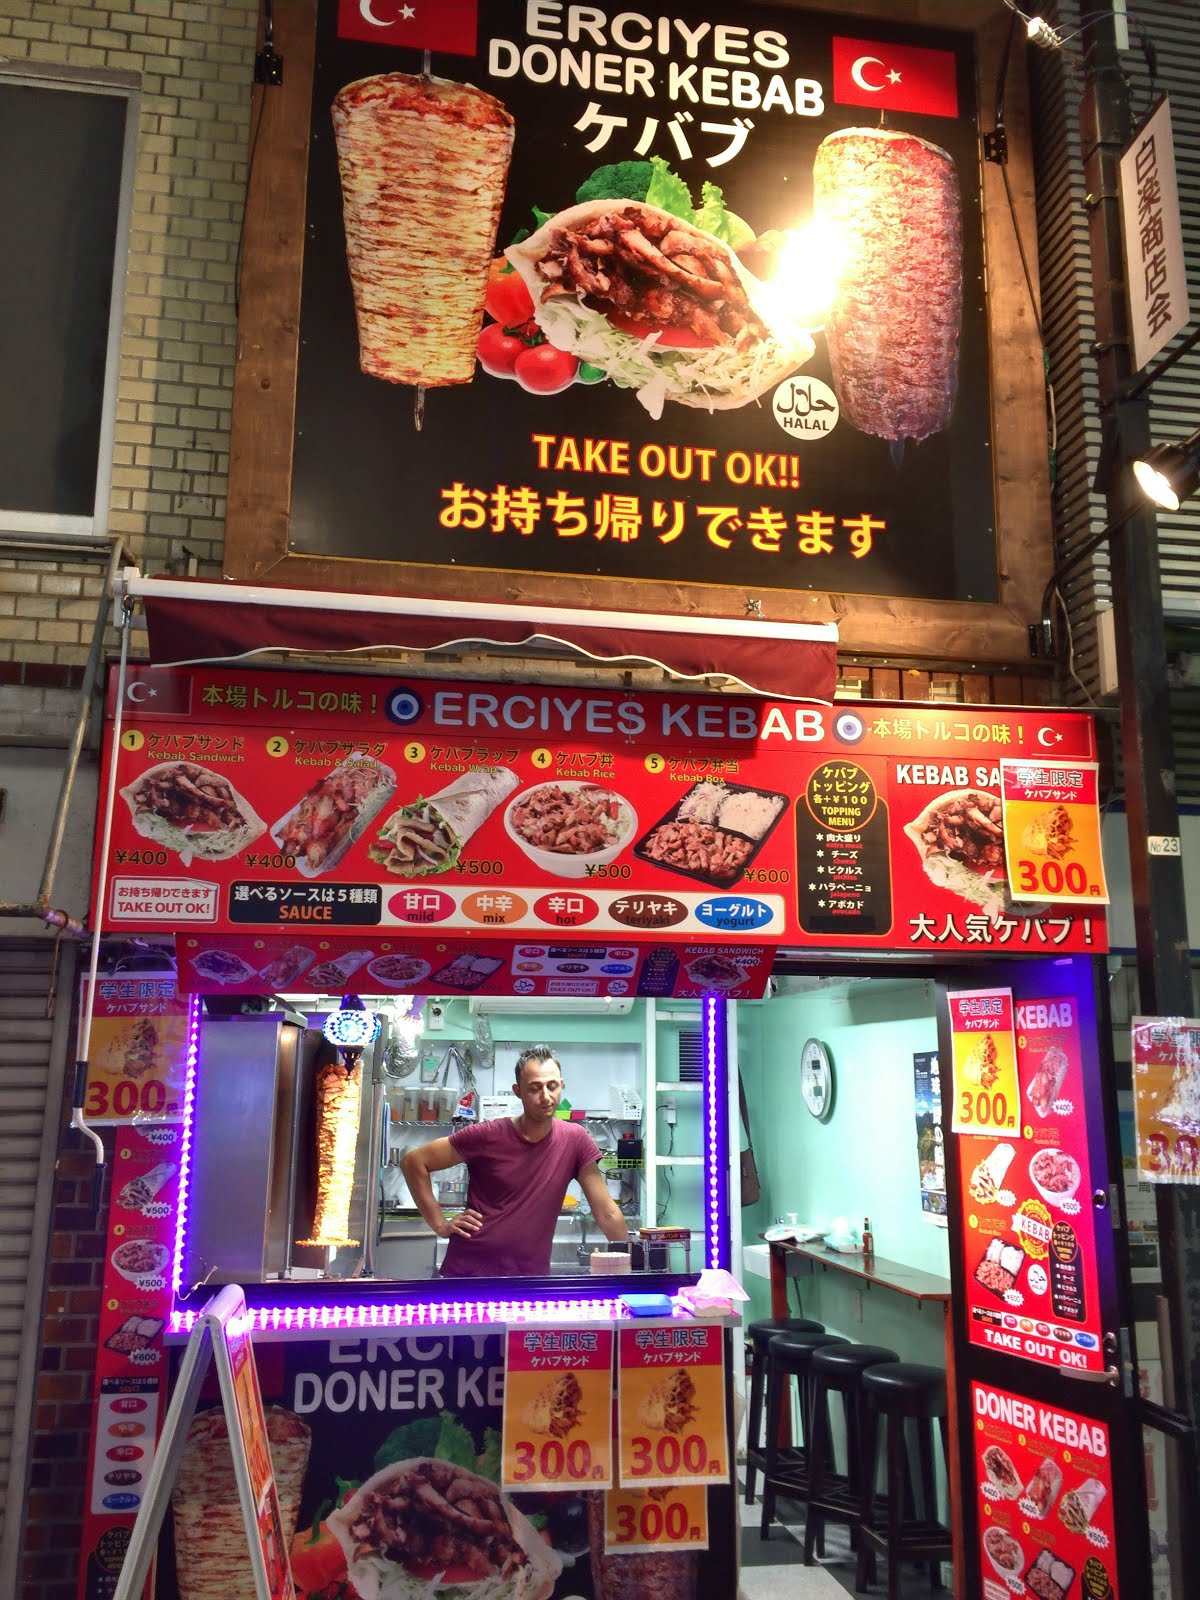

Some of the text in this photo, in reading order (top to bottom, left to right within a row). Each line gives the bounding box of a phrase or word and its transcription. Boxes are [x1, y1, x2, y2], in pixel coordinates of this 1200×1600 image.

[526, 0, 790, 69] ERCIYES
[488, 38, 825, 117] DONER KEBAB
[573, 101, 755, 168] ケバブ
[1134, 134, 1172, 339] 白楽商店会
[777, 383, 836, 415] حلال
[783, 416, 830, 432] HALAL
[532, 433, 801, 489] TAKE OUT OK!!
[438, 482, 886, 558] お持ち帰りできます
[201, 684, 378, 714] 本場トルコの味！
[433, 691, 825, 742] ERCIYES KEBAB
[873, 717, 1024, 745] 本場トルコの味！
[148, 733, 246, 751] ケバブサンド
[294, 739, 387, 758] ケバブサラダ
[147, 750, 245, 763] Kebab Sandwich
[430, 745, 520, 763] ケバブラップ
[555, 751, 614, 767] ケバブ丼
[295, 757, 378, 768] Kebab & Salad
[430, 762, 497, 776] Kebab Wrap
[668, 756, 739, 774] ケバブ弁当
[556, 768, 615, 779] Kebab Rice
[670, 773, 725, 783] Kebab Box
[822, 767, 858, 779] ケバブ
[896, 764, 969, 786] KEBAB
[1016, 768, 1084, 789] 学生限定
[812, 780, 871, 793] トッピング
[1024, 789, 1078, 801] ケバブサンド
[822, 807, 861, 817] TOPPING
[828, 817, 855, 827] MENU
[826, 833, 861, 843] 肉大盛り
[1163, 838, 1178, 852] 23
[115, 850, 168, 866] ¥400
[245, 853, 297, 869] ¥400
[831, 850, 858, 859] チーズ
[455, 860, 504, 875] ¥500
[585, 864, 632, 879] ¥500
[744, 868, 790, 883] ¥600
[828, 865, 863, 875] ピクルス
[118, 886, 212, 899] お持ち帰りできます
[234, 885, 378, 904] 選べるソースは5種類
[819, 883, 872, 892] ハラペーニョ
[118, 901, 211, 914] TAKE OUT OK!
[403, 893, 440, 911] 甘口
[476, 894, 513, 912] 中辛
[548, 896, 584, 914] 辛口
[615, 899, 678, 916] テリヤキ
[828, 900, 864, 910] アボカド
[279, 905, 332, 920] SAUCE
[407, 910, 434, 923] mild
[483, 912, 505, 924] mix
[701, 903, 767, 918] ヨーグルト
[556, 914, 576, 925] hot
[625, 914, 670, 928] teriyaki
[716, 915, 755, 930] yogurt
[908, 913, 1093, 945] 大人気ケバブ！
[99, 981, 175, 999] 学生限定
[106, 1002, 168, 1013] ケバブサンド
[959, 998, 1003, 1017] 学生限定
[965, 1018, 1000, 1029] ケバブサンド
[1015, 1003, 1073, 1030] KEBAB
[1152, 1028, 1200, 1048] 学生限
[151, 1132, 174, 1142] ¥400
[146, 1206, 169, 1215] ¥500
[1022, 1219, 1050, 1241] KEBAB
[138, 1279, 163, 1288] ¥500
[524, 1332, 598, 1351] 学生限定
[636, 1329, 708, 1348] 学生限定
[984, 1329, 1087, 1368] TAKE OUT OK!
[132, 1352, 157, 1362] ¥600
[531, 1355, 590, 1367] ケバブサンド
[643, 1352, 701, 1363] ケバブサンド
[294, 1367, 445, 1413] DONER
[975, 1388, 1036, 1433] DONER
[1039, 1408, 1107, 1457] KEBAB
[513, 1439, 605, 1481] 300円
[630, 1434, 721, 1476] 300円
[616, 1502, 701, 1542] 300円
[100, 1540, 130, 1548] トッピン
